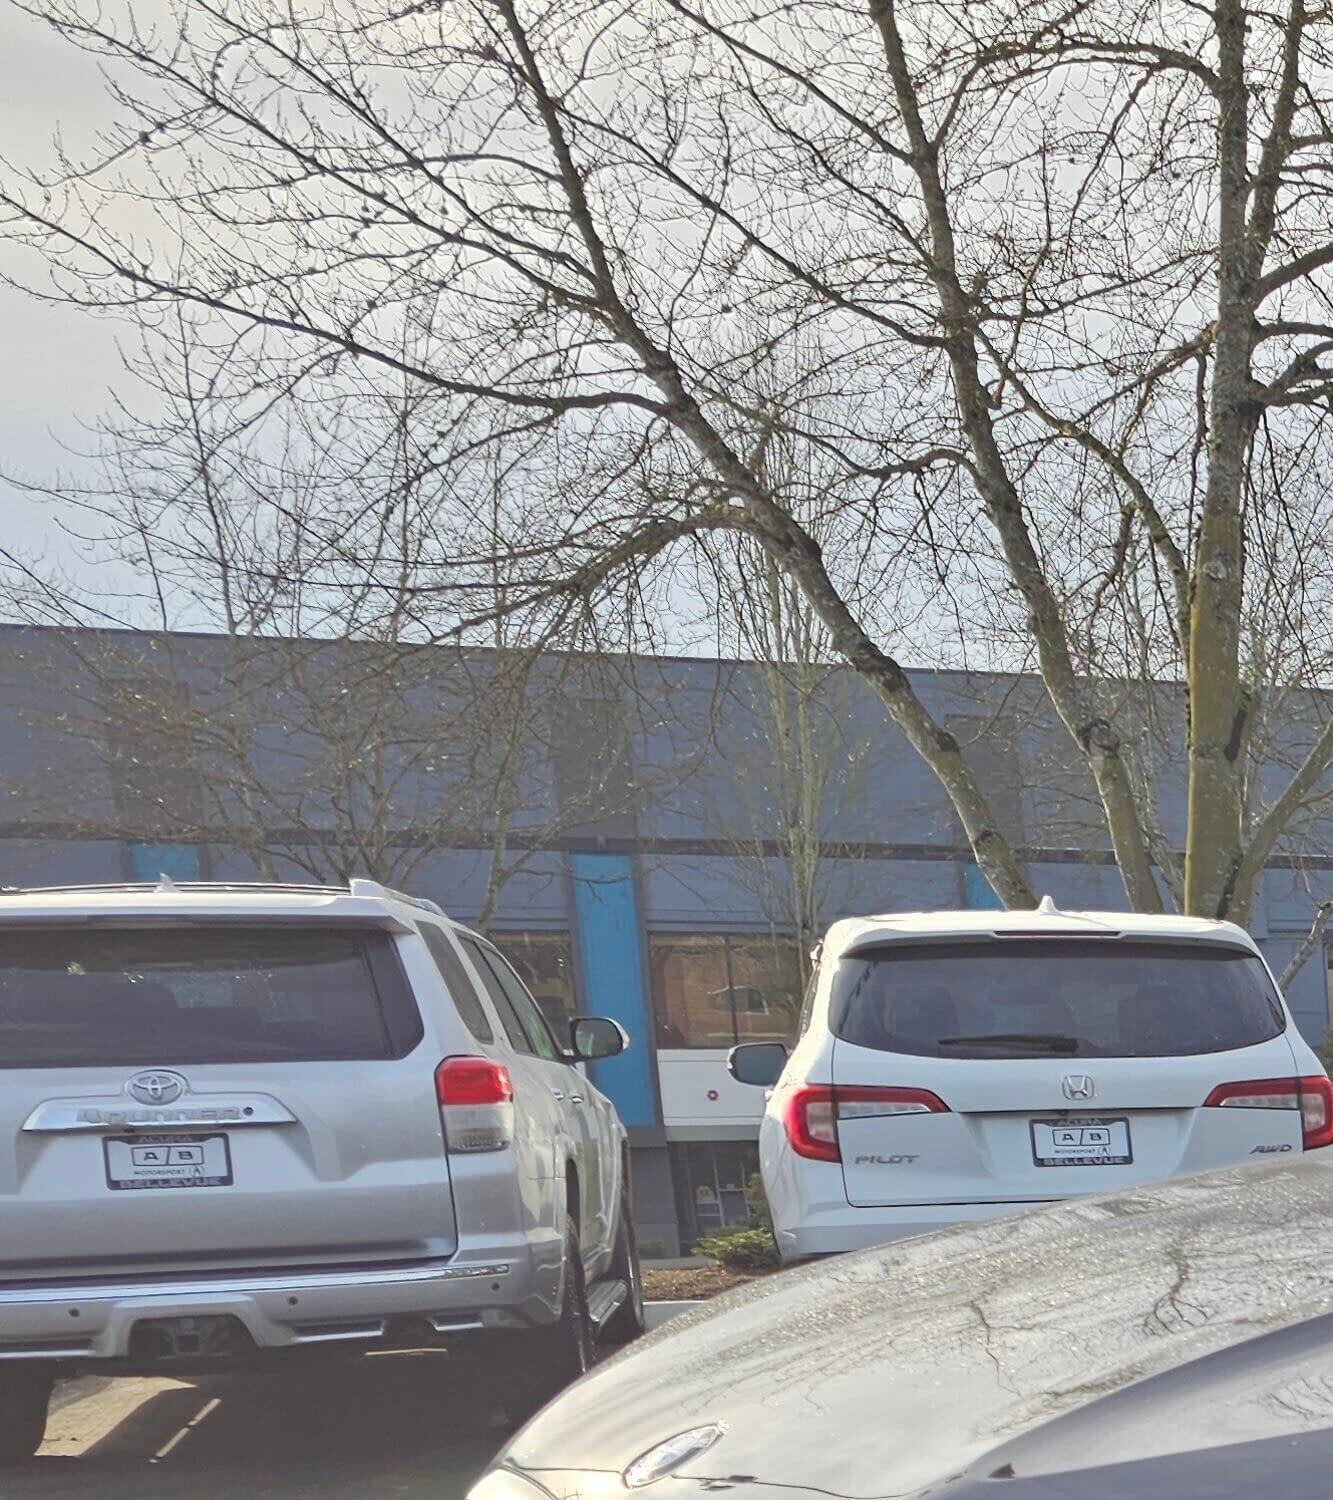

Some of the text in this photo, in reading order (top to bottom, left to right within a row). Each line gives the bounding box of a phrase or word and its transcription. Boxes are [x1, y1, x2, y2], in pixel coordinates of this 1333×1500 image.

[1249, 1144, 1292, 1155] AWD
[143, 1150, 194, 1161] A B
[855, 1154, 920, 1165] PILOT
[119, 1177, 222, 1189] BELLEVUE
